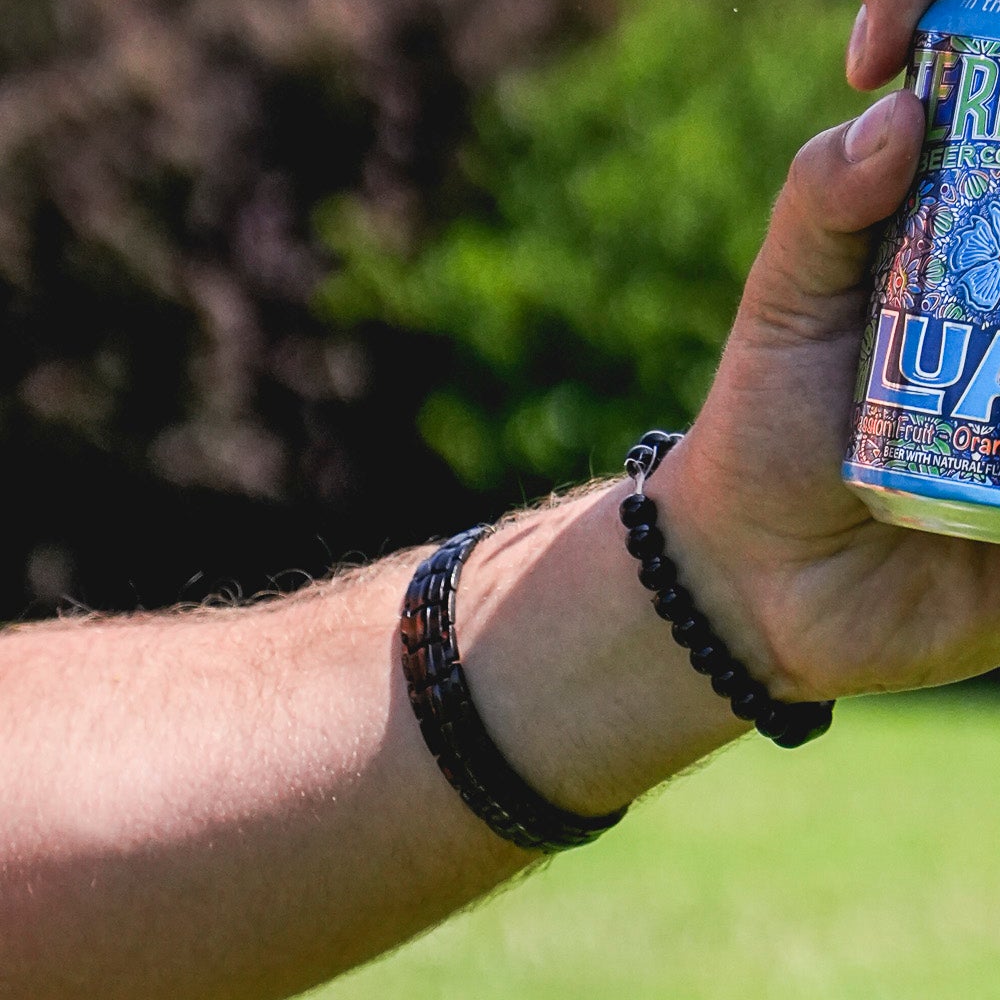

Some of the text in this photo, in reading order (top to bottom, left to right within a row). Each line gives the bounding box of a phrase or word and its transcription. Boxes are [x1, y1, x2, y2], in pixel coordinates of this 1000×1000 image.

[896, 415, 935, 444] Fruit
[883, 446, 904, 460] BEER
[905, 451, 931, 465] WITH
[932, 455, 983, 474] NATURAL
